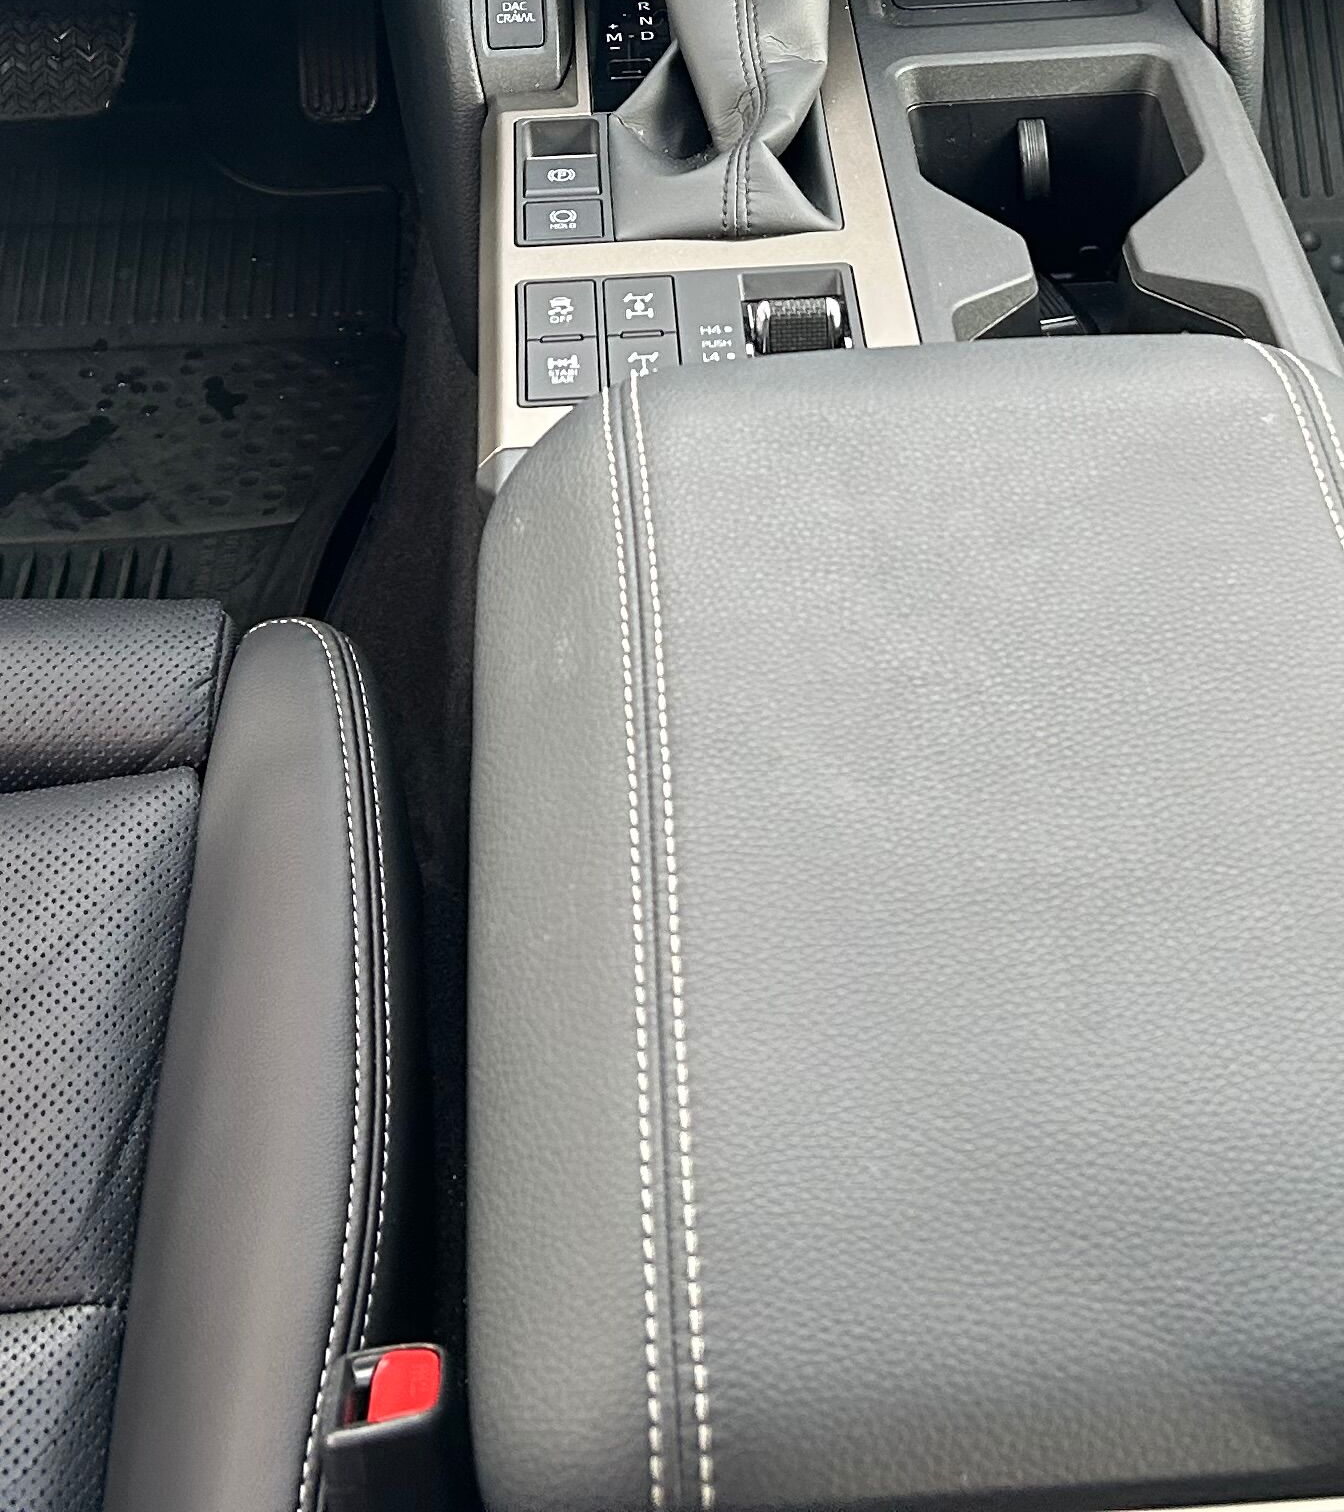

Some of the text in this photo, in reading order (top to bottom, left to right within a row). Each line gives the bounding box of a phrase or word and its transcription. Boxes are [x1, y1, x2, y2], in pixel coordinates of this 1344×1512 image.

[502, 1, 527, 12] DAC
[638, 1, 651, 11] R
[496, 12, 536, 23] CRAWL
[639, 16, 653, 26] N
[606, 32, 623, 42] M
[640, 31, 654, 41] D
[549, 315, 573, 324] OFF
[699, 324, 721, 336] H4
[702, 351, 720, 363] L4
